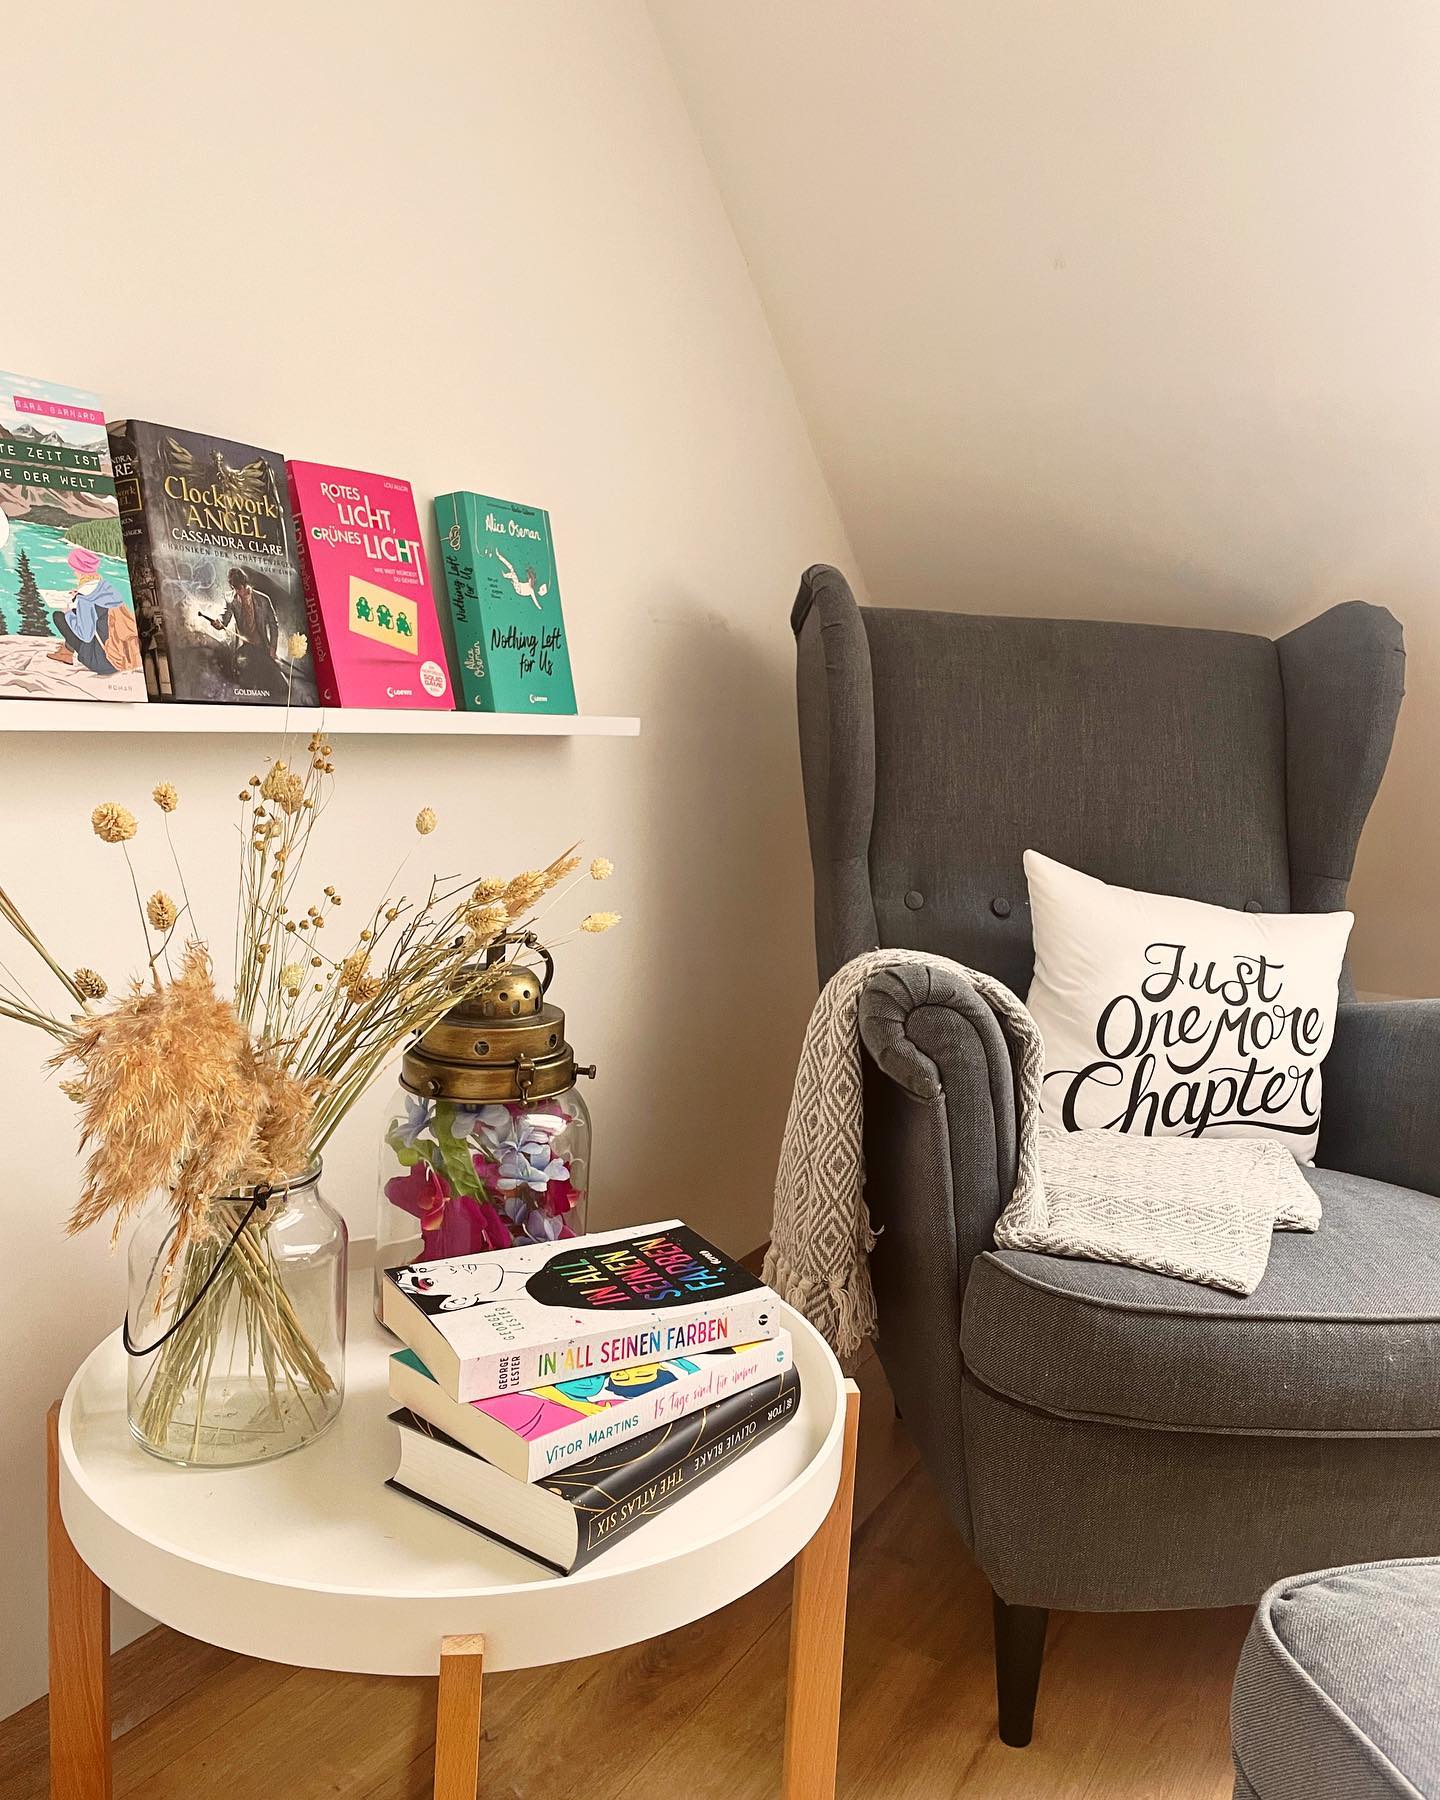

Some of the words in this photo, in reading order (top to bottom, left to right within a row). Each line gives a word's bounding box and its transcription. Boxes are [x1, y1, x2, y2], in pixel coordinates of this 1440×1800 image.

[26, 446, 62, 461] ZEIT
[74, 453, 99, 467] IST
[23, 470, 51, 483] DER
[60, 475, 95, 488] WELT
[320, 482, 360, 503] ROTES
[164, 475, 278, 519] Clockwork
[186, 504, 267, 539] ANGEL
[486, 513, 506, 533] Alice
[509, 519, 541, 541] Oseman
[172, 527, 245, 550] CASSANDRA
[248, 541, 283, 556] CLARE
[311, 526, 361, 548] GRÜNES
[363, 534, 424, 586] LICHT
[491, 625, 538, 656] Nothing
[541, 626, 561, 651] Left
[520, 653, 535, 679] for
[540, 651, 553, 676] Us
[234, 687, 271, 697] GOLDMANN
[1141, 942, 1284, 1006] Just
[1096, 994, 1212, 1060] One
[1040, 1053, 1320, 1138] Chapter
[553, 1258, 609, 1284] ALL
[594, 1250, 682, 1301] SEINEN
[632, 1237, 725, 1291] FARBEN
[580, 1285, 631, 1305] IN
[538, 1352, 556, 1377] IN
[564, 1345, 593, 1370] ALL
[600, 1329, 662, 1364] SEINEN
[667, 1317, 729, 1349] FARBEN
[498, 1356, 509, 1390] GEORGE
[511, 1355, 521, 1387] LESTER
[654, 1397, 665, 1419] 15
[726, 1420, 757, 1451] OLIVIE
[693, 1445, 724, 1472] BLAKE
[659, 1468, 684, 1493] THE
[621, 1486, 658, 1520] ATLAS
[597, 1511, 618, 1538] SIX
